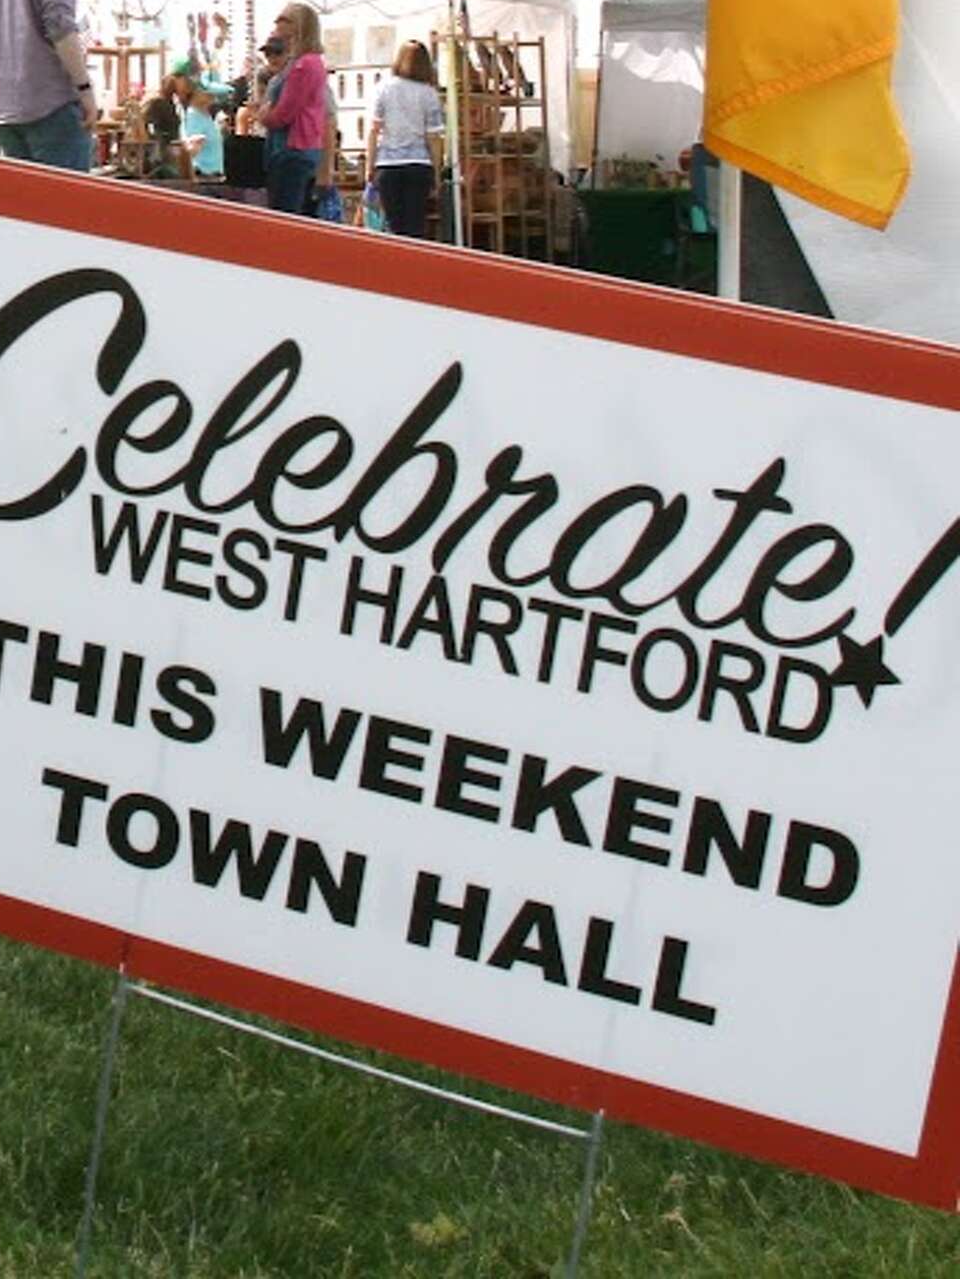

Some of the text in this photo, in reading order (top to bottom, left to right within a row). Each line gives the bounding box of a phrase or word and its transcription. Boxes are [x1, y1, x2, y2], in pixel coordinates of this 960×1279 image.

[91, 494, 836, 745] WEST HARTFORD
[41, 767, 716, 1026] TOWN HALL
[260, 687, 860, 907] WEEKEND
